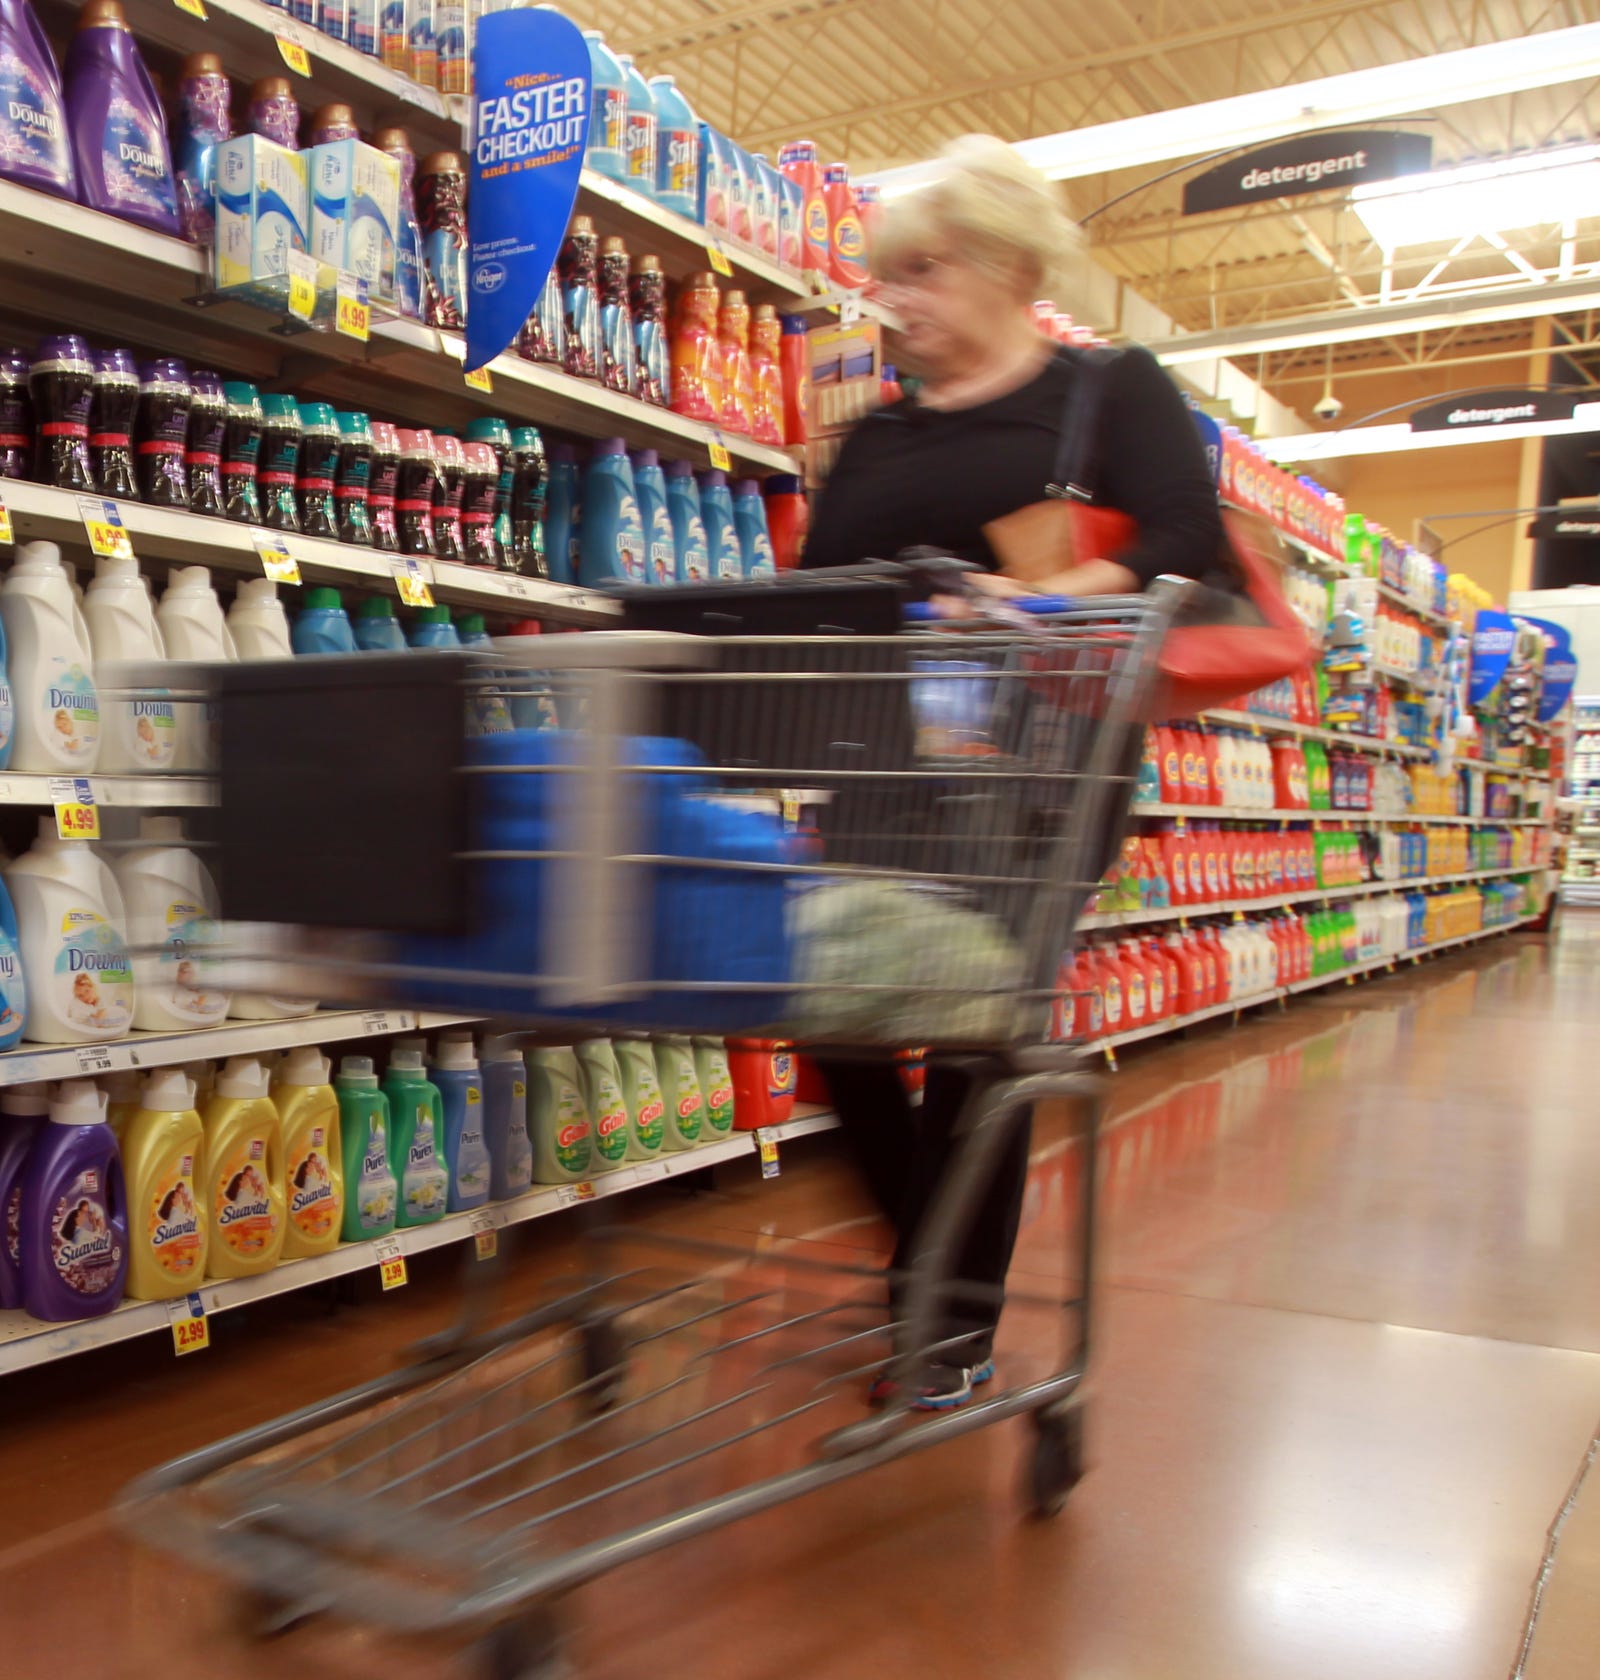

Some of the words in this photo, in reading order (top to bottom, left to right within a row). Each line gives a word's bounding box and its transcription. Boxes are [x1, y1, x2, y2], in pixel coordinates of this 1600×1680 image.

[478, 77, 585, 137] FASTER
[8, 102, 59, 139] Downy
[477, 115, 586, 164] CHECKOUT
[119, 143, 164, 177] Downy
[482, 161, 509, 179] and
[512, 163, 520, 172] a
[1240, 150, 1367, 191] detergent
[1447, 402, 1536, 424] detergent
[63, 808, 95, 831] 4.99
[69, 948, 128, 974] Downy
[679, 1093, 702, 1118] Gain
[709, 1087, 733, 1109] Gain
[598, 1110, 627, 1137] Gain
[638, 1101, 664, 1127] Gain
[558, 1120, 591, 1148] Gain
[410, 1145, 432, 1163] Purex
[292, 1181, 332, 1211] Suavitel
[220, 1200, 269, 1225] Suavitel
[153, 1218, 197, 1244] Suavitel
[58, 1232, 109, 1267] Suavitel
[385, 1263, 402, 1281] 2.99
[178, 1320, 204, 1345] 2.99
